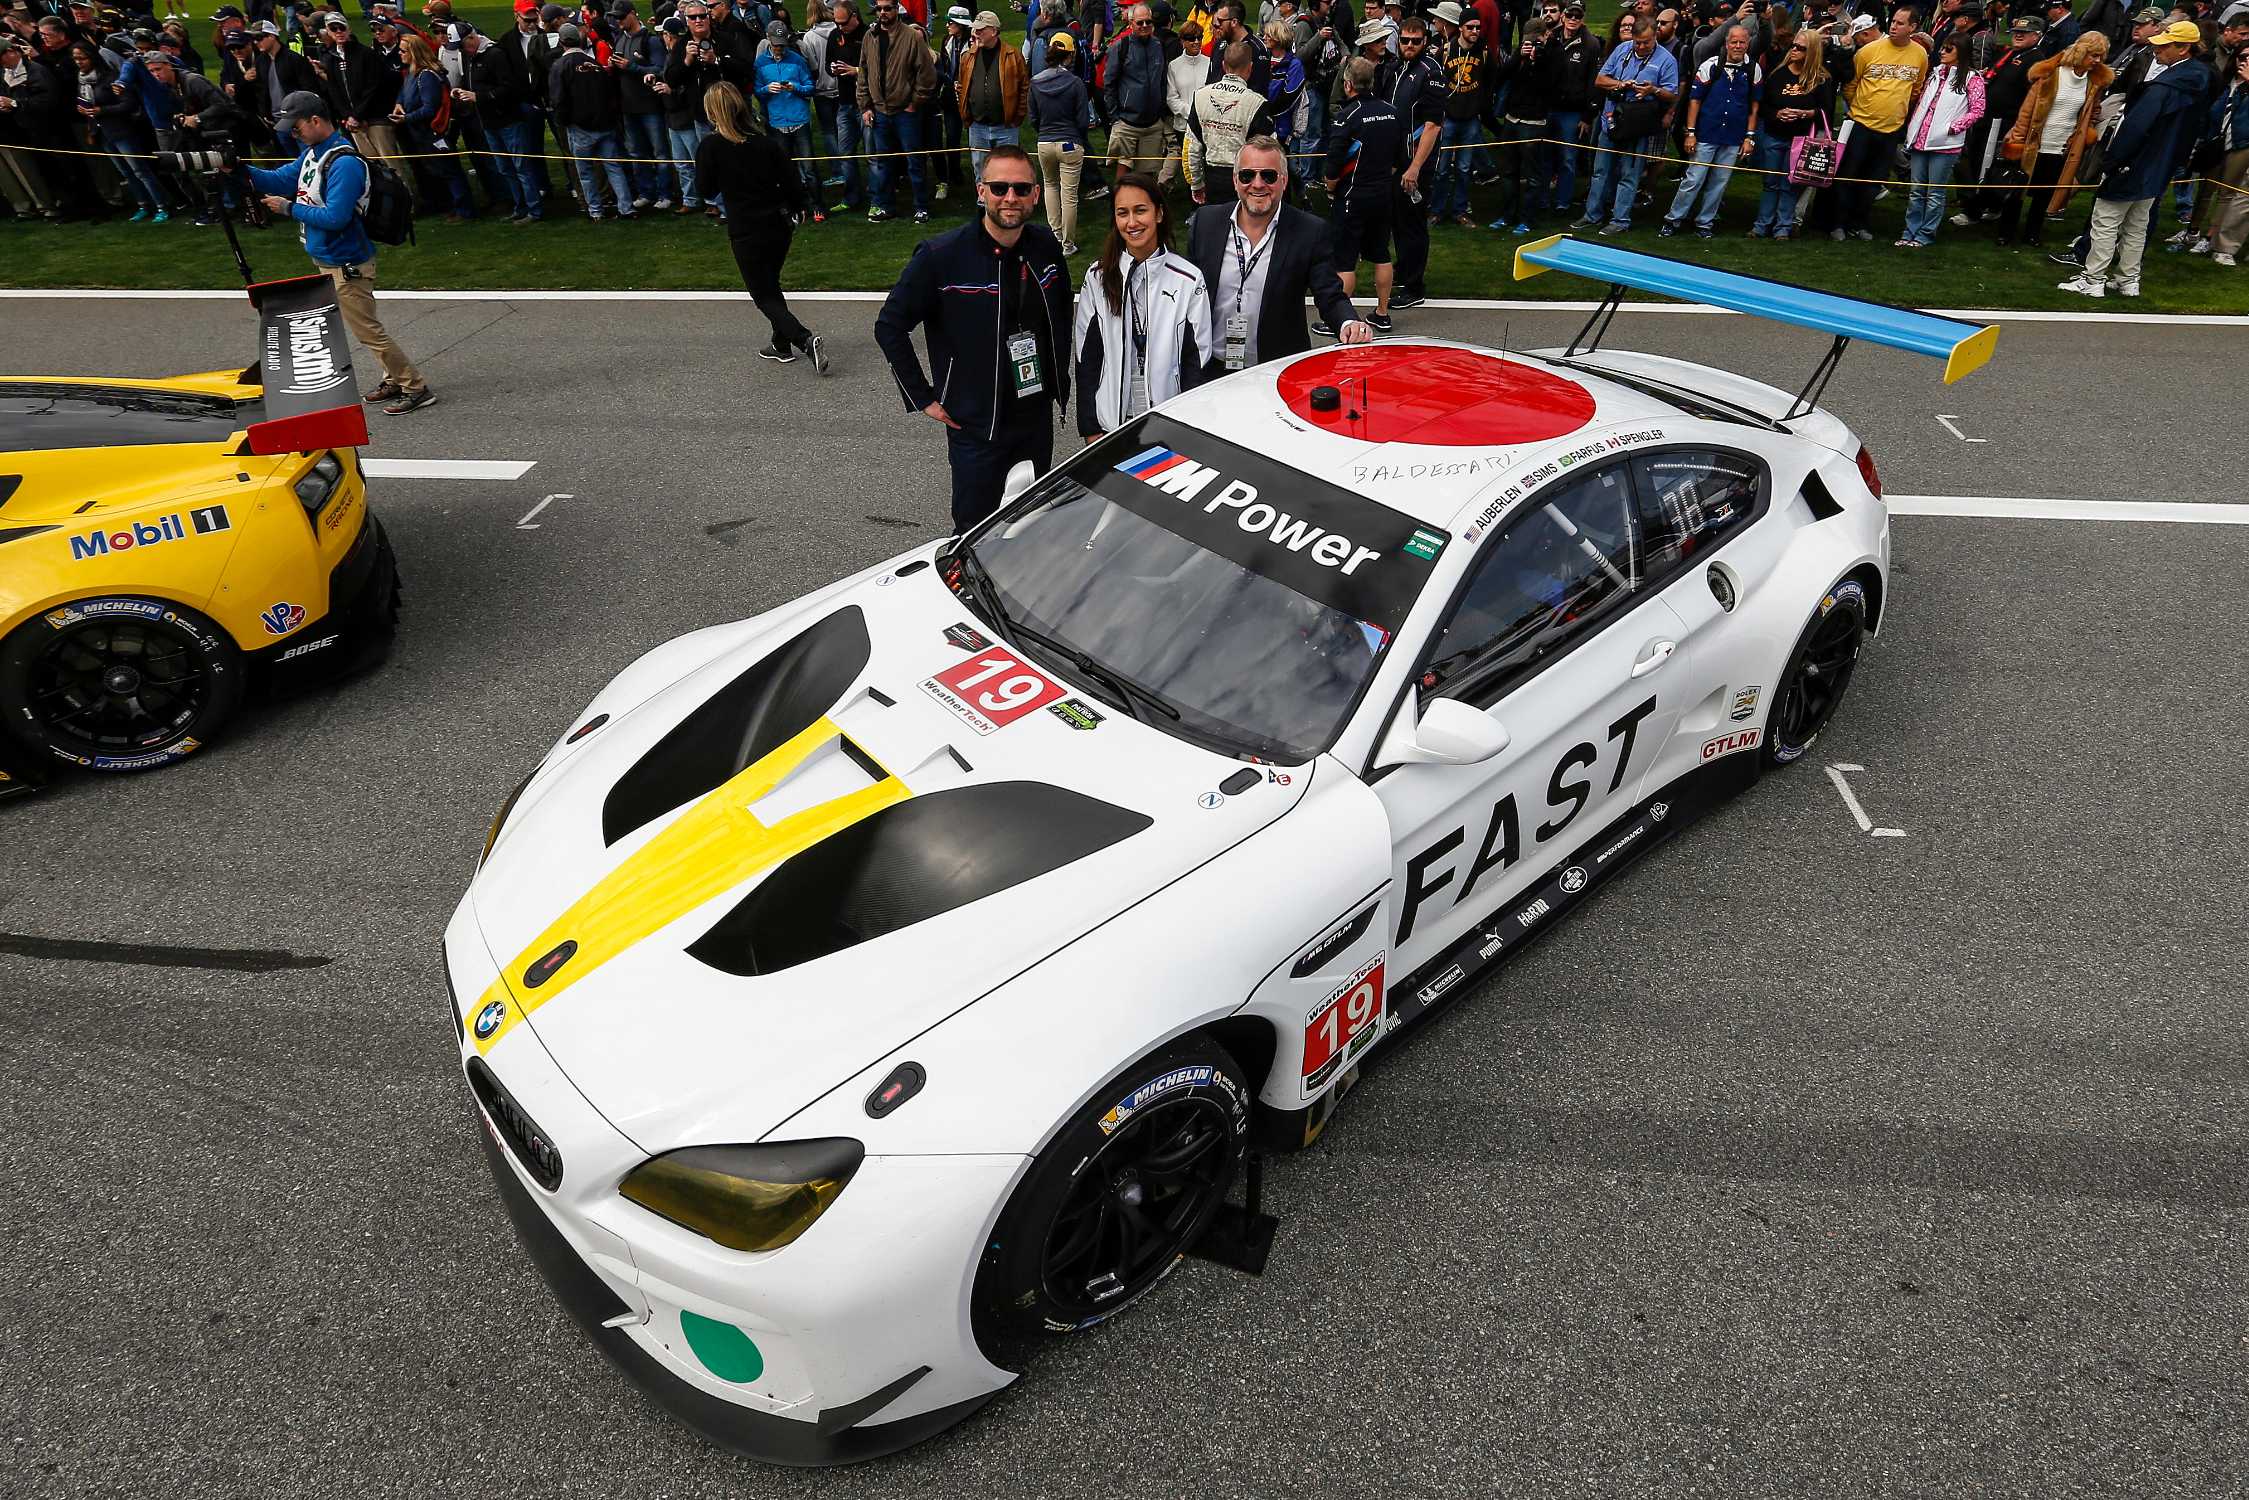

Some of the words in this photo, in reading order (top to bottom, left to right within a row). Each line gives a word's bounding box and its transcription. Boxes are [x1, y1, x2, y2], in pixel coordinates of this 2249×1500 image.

[1211, 83, 1246, 95] LONGHI
[267, 350, 281, 371] RADIO
[1021, 365, 1031, 379] P
[1619, 429, 1665, 447] SPENGLER
[1571, 442, 1606, 463] FARFUS
[1532, 463, 1559, 482] SIMS
[1144, 458, 1222, 503] M
[1203, 478, 1382, 576] Power
[1475, 485, 1522, 531] AUBERLEN
[70, 513, 185, 561] Mobil
[1416, 542, 1435, 555] DEKRA
[1837, 583, 1861, 600] MICHELIN
[83, 602, 161, 615] MICHELIN
[260, 602, 292, 634] VP
[279, 635, 338, 661] BOSE
[955, 659, 1045, 711] 19
[1735, 687, 1758, 699] ROLEX
[923, 680, 993, 732] WeatherTech
[1735, 695, 1756, 708] 24
[1702, 731, 1758, 759] GTLM
[95, 754, 169, 769] MICHELIN
[1394, 694, 1657, 950] FAST
[1604, 825, 1644, 859] PERFORMANCE
[1324, 921, 1354, 951] GTLM
[1479, 938, 1503, 960] PUMA
[1308, 954, 1383, 1022] WeatherTech
[1434, 968, 1461, 991] MICHELIN
[1319, 982, 1374, 1056] 19
[1134, 1068, 1210, 1107] MICHELIN
